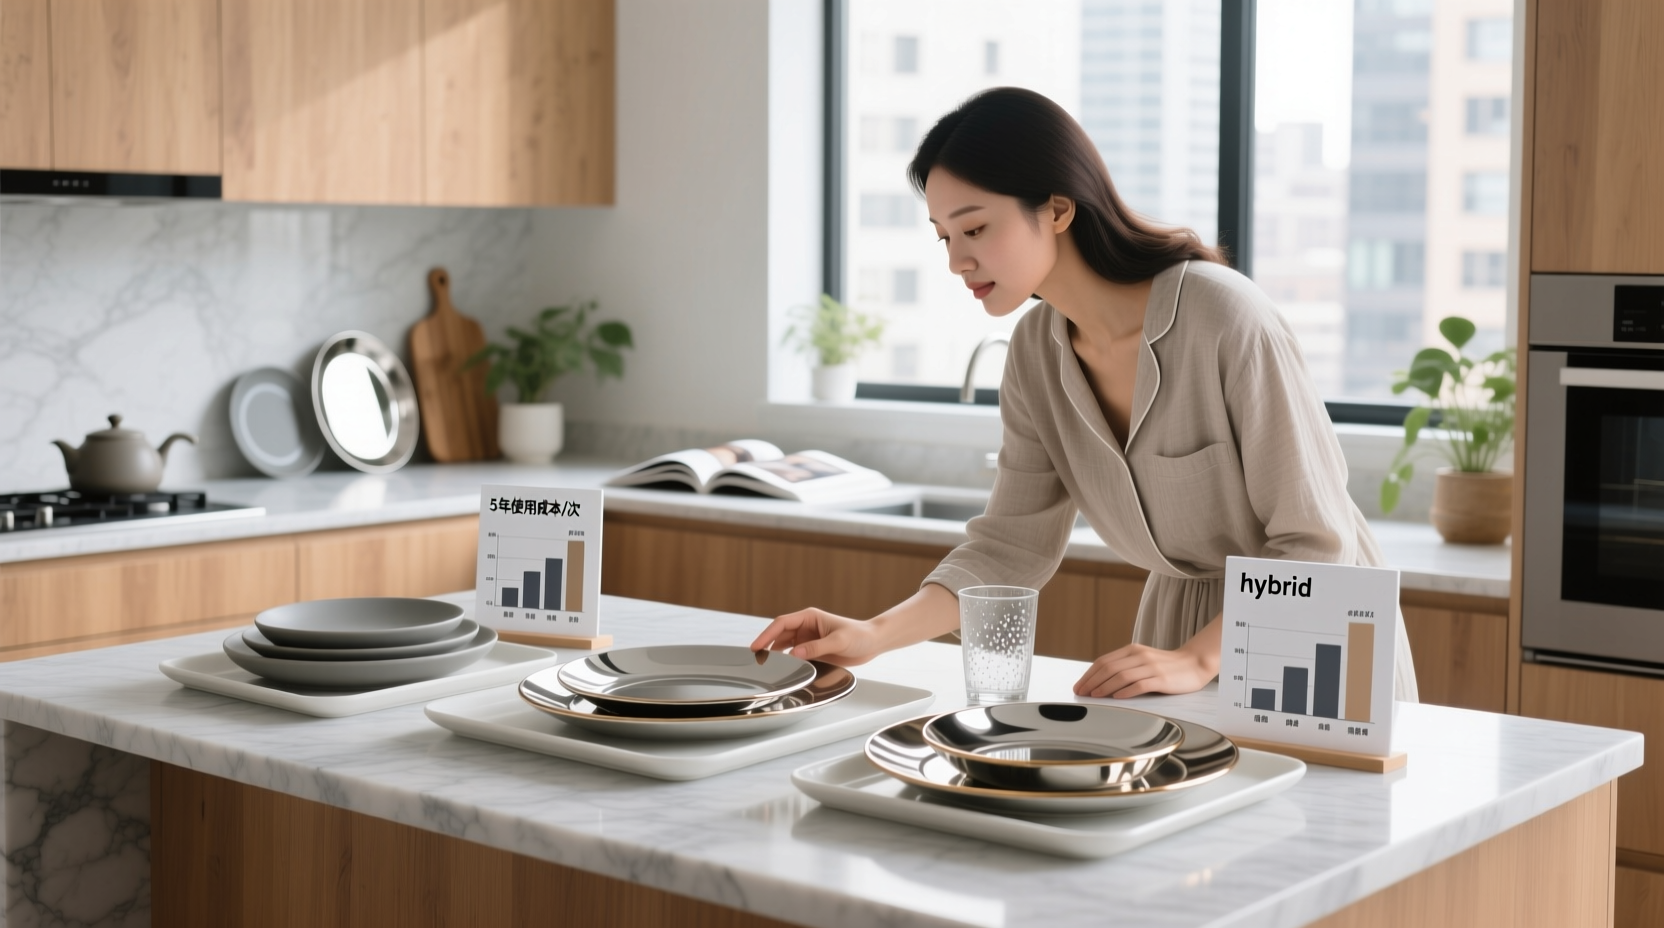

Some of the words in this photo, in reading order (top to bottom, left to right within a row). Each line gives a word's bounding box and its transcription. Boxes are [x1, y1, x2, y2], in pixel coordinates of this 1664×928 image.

[489, 496, 581, 517] 5年使用成本/次
[1240, 572, 1312, 600] hybrid
